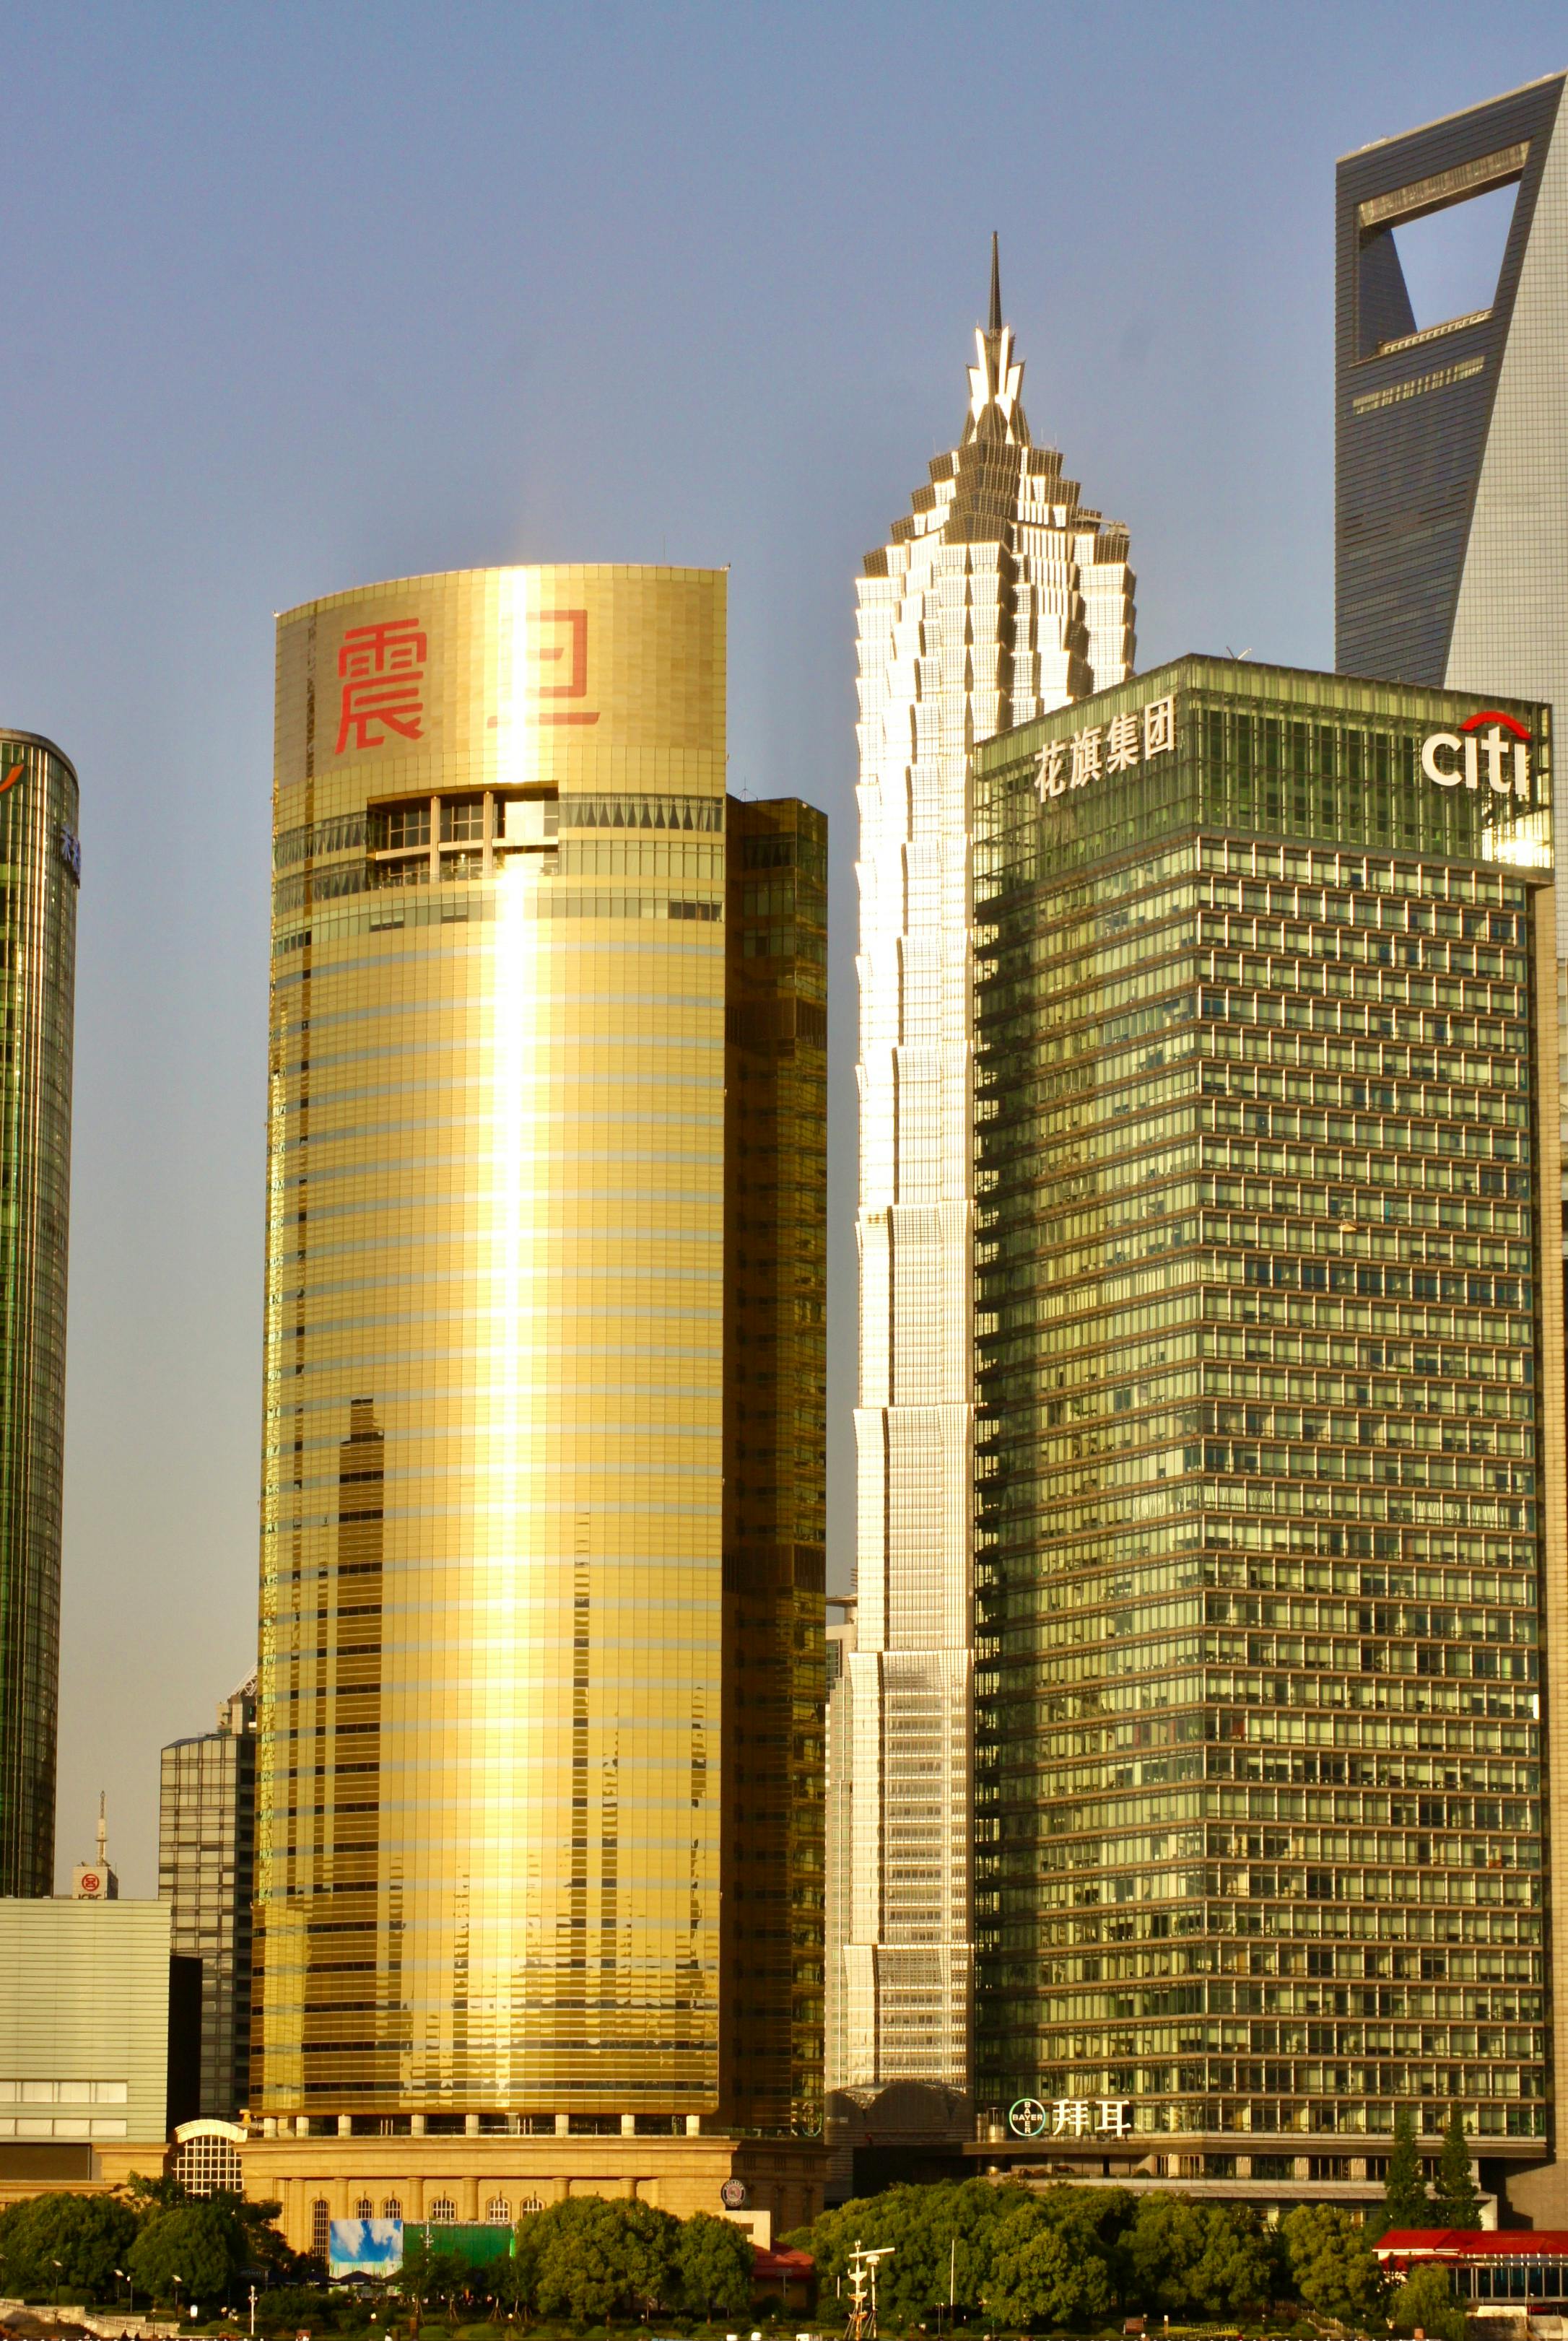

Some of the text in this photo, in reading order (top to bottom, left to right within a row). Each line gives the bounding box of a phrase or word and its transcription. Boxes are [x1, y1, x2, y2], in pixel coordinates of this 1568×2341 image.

[334, 609, 601, 754] 震旦
[1034, 694, 1175, 803] 花旗集团
[1421, 726, 1527, 795] citi
[1053, 2098, 1131, 2137] 拜耳
